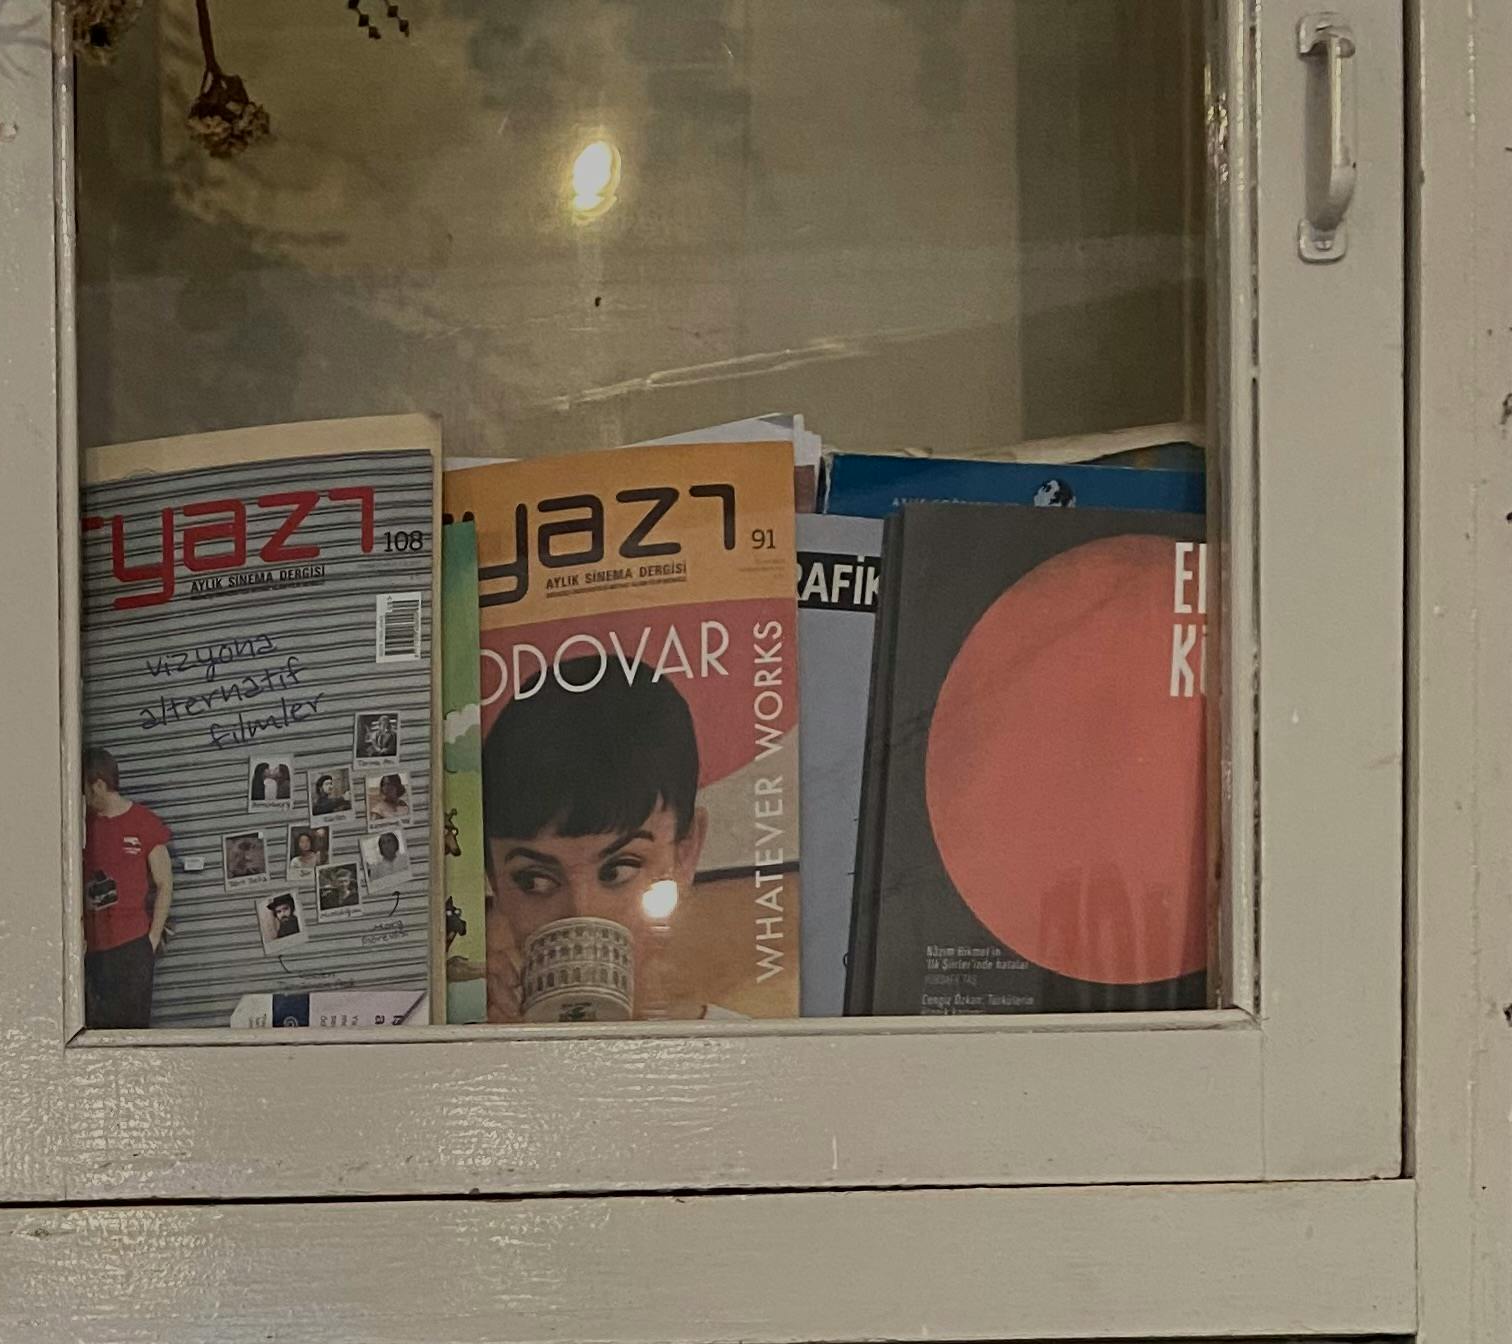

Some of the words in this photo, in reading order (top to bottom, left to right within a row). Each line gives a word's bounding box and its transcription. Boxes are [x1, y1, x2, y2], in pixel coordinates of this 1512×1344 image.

[384, 530, 424, 552] 108
[752, 529, 777, 550] 91
[190, 577, 222, 593] AYLIK
[228, 570, 274, 588] SİNEMA
[279, 563, 327, 582] DERGİSİ
[545, 573, 580, 589] AYLIK
[584, 564, 634, 584] SİNEMA
[638, 560, 687, 580] DERGİSİ
[139, 655, 306, 730] alternatif
[752, 618, 784, 761] WORKS
[209, 691, 325, 751] filmler
[754, 776, 784, 984] WHATEVER
